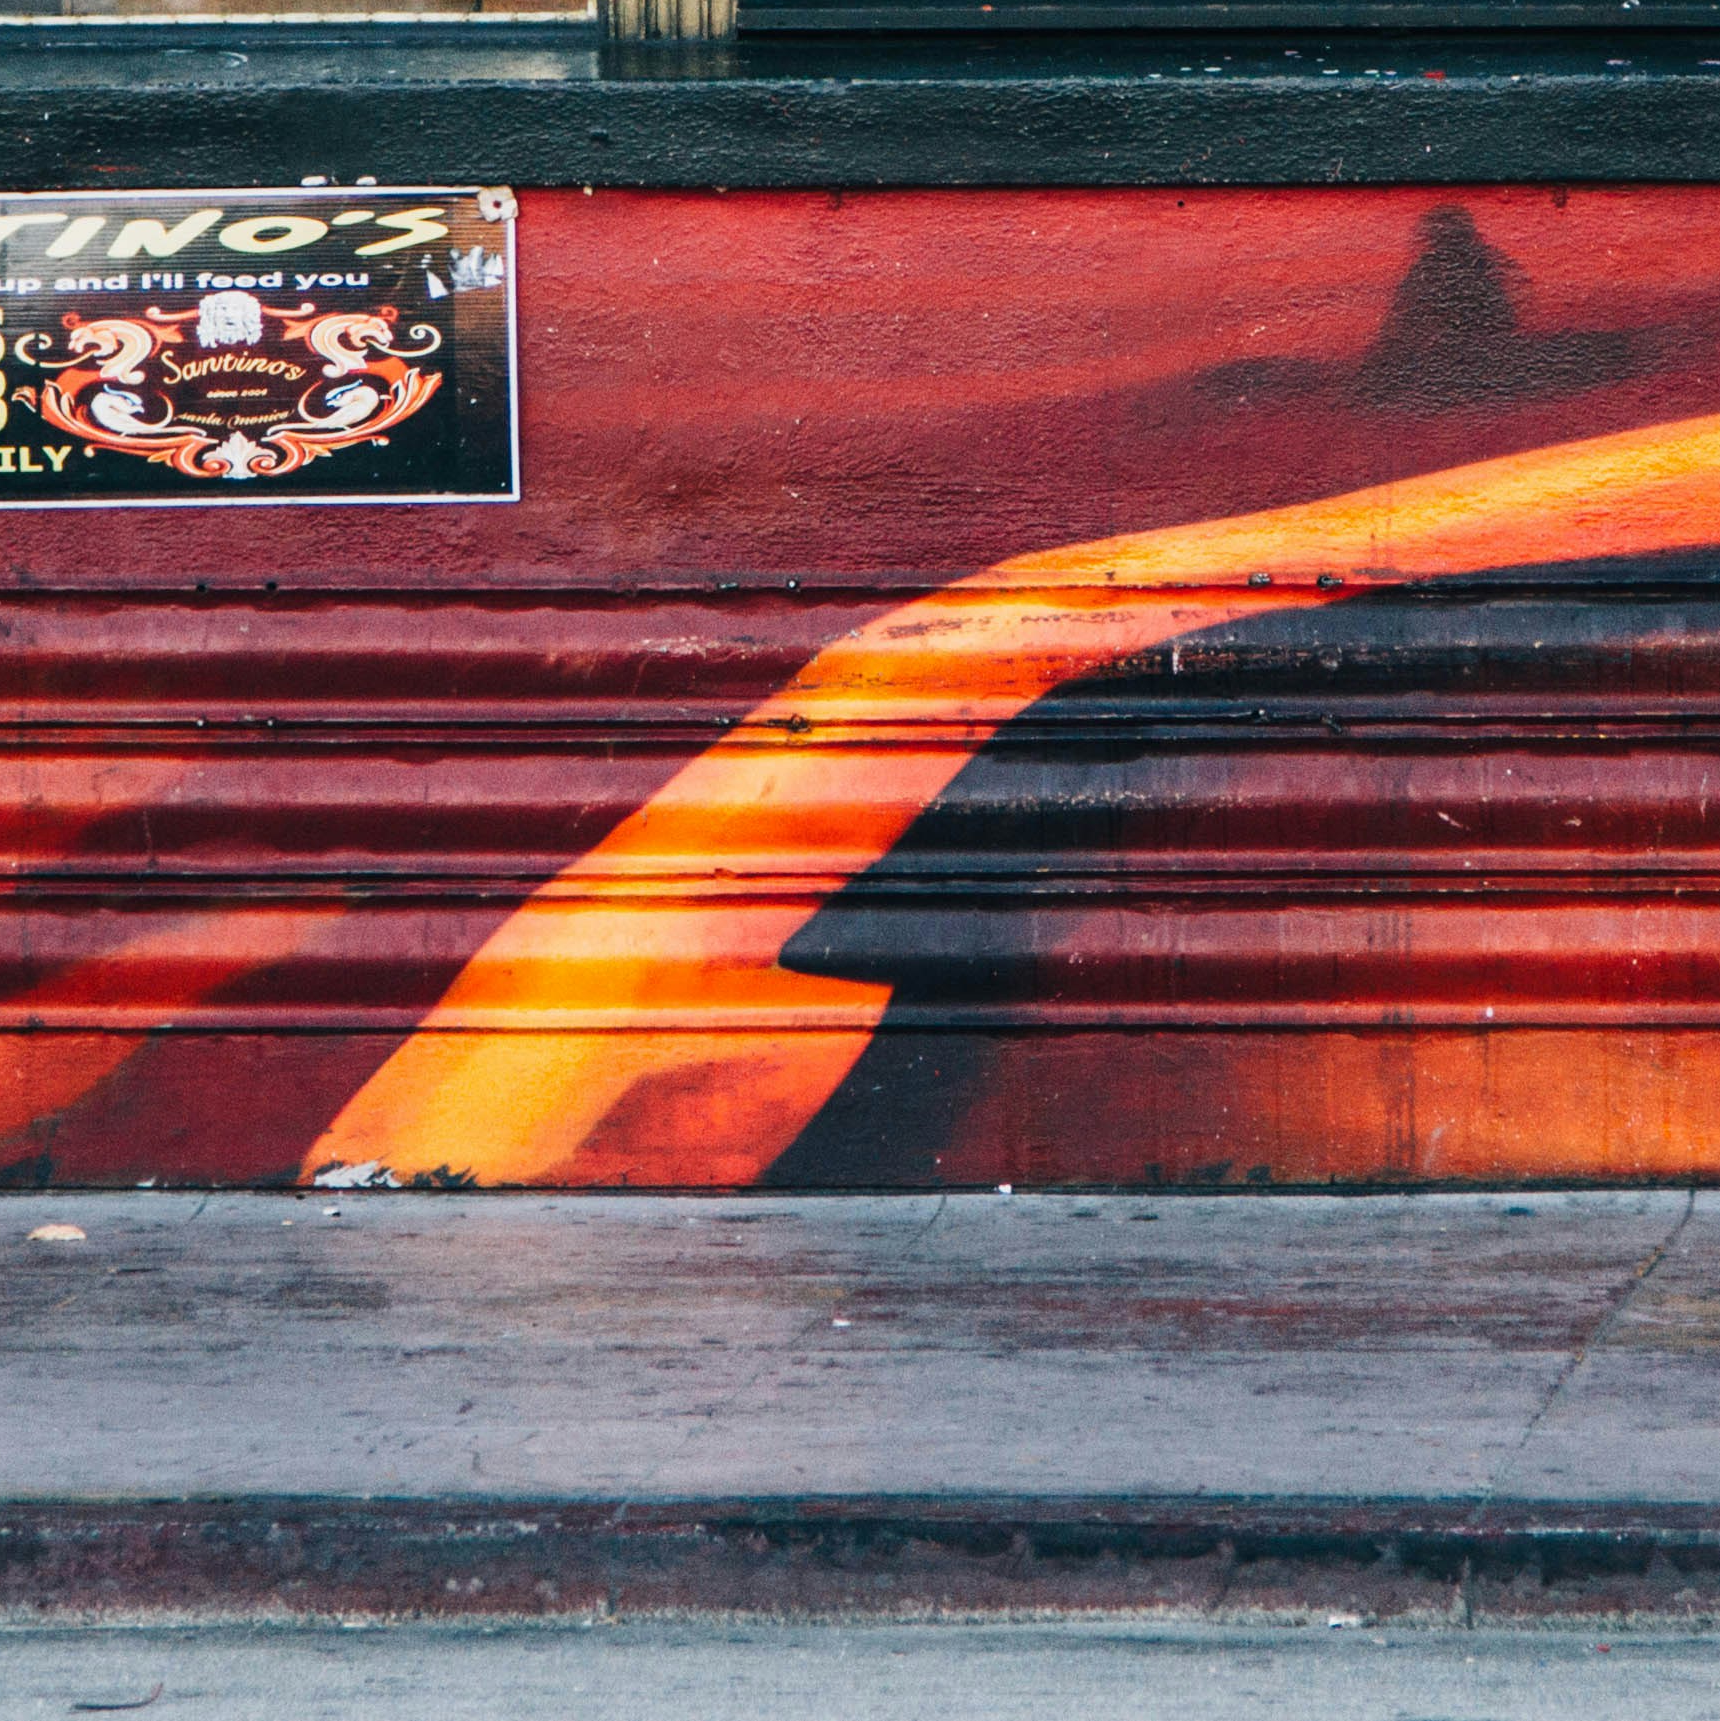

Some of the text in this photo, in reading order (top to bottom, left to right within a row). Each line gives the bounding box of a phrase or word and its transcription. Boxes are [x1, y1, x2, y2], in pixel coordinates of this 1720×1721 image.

[53, 274, 129, 292] and
[140, 272, 184, 290] I'll
[196, 271, 283, 290] feed
[294, 270, 370, 291] you
